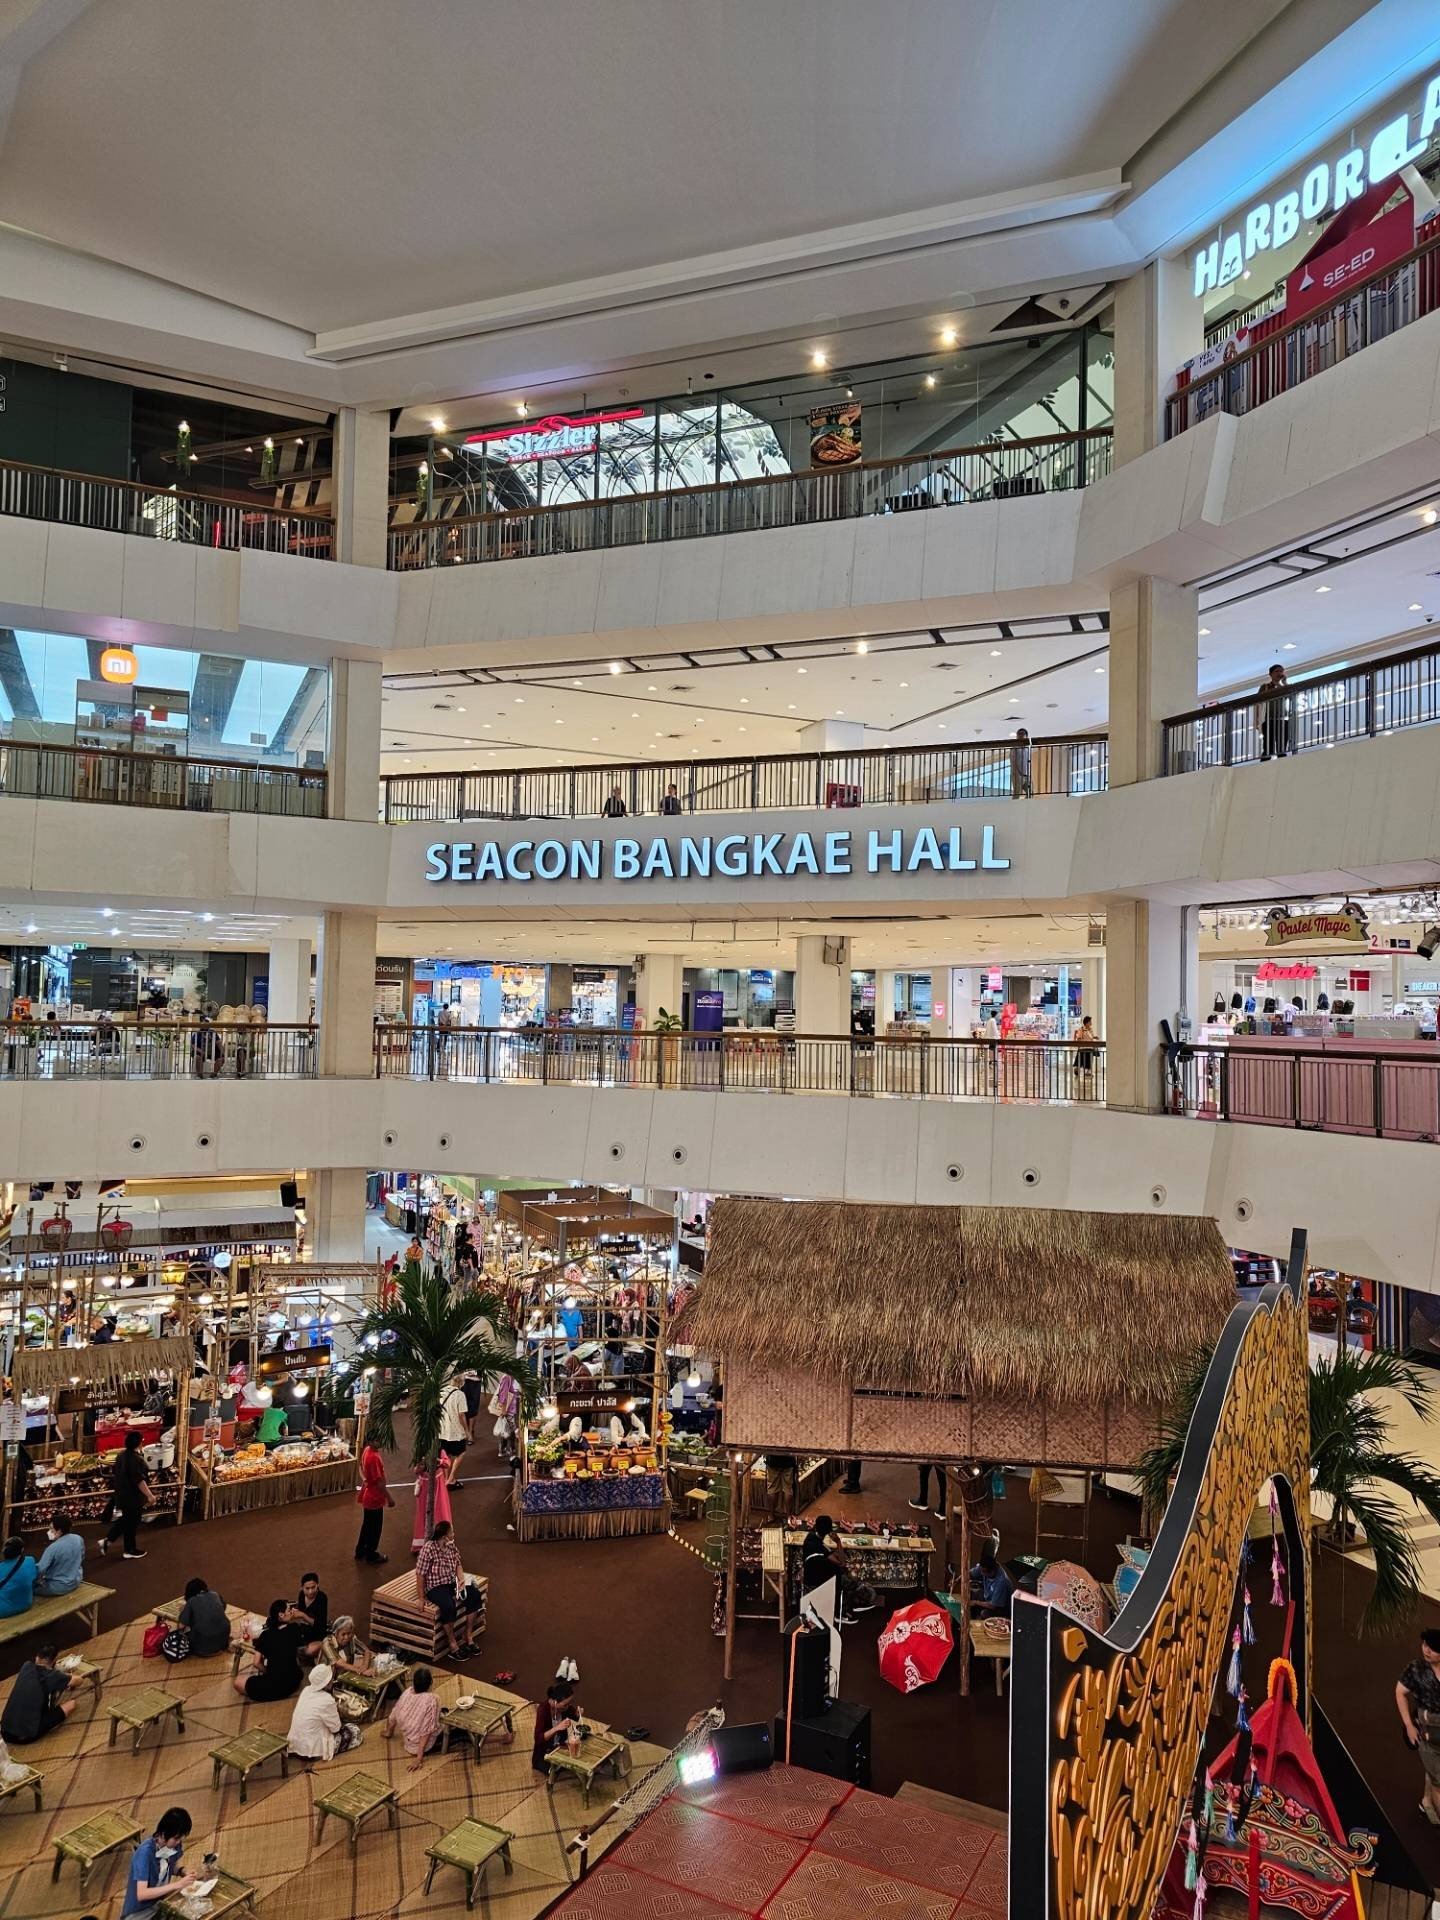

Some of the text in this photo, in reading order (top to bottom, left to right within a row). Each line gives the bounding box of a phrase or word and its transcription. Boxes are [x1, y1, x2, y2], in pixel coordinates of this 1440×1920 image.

[1323, 247, 1375, 287] SE-ED
[507, 425, 598, 457] Sizzler
[424, 824, 1011, 882] SEACON BANGKAE HALL
[1277, 916, 1351, 939] Pastel Magic
[1371, 934, 1378, 947] 2
